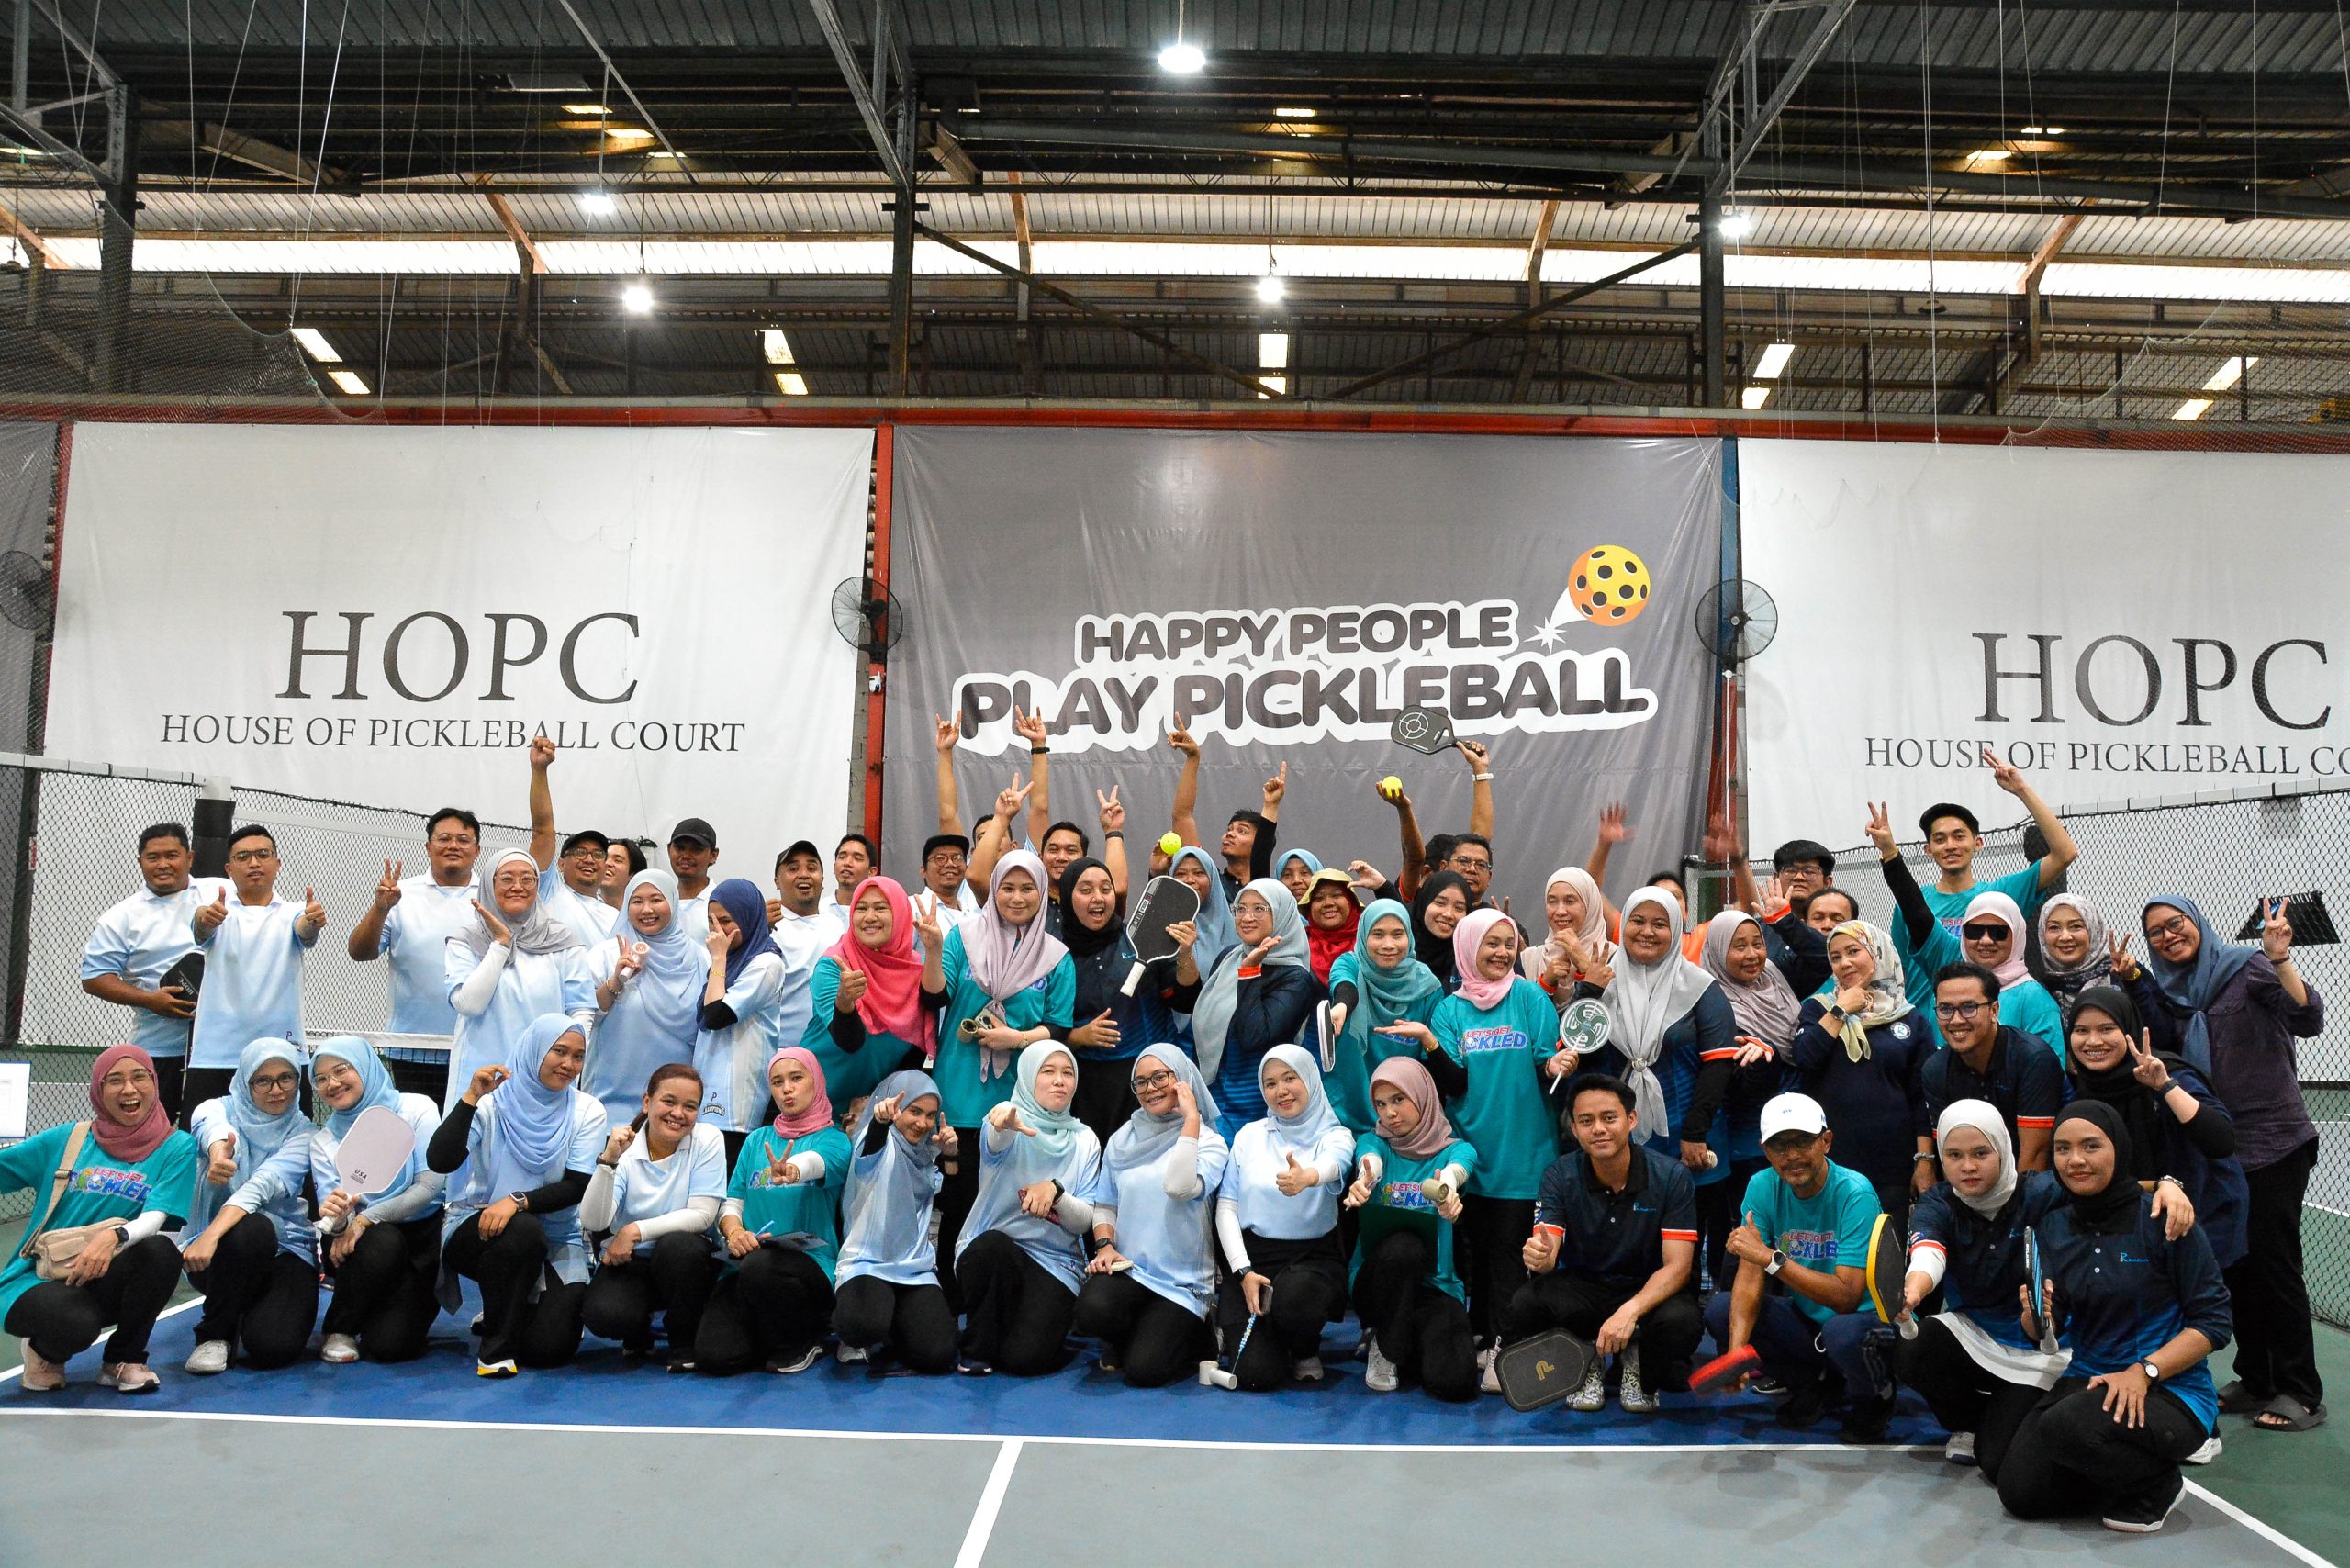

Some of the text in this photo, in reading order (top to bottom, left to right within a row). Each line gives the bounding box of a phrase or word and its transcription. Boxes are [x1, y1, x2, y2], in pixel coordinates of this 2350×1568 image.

[1081, 607, 1512, 663] HAPPY PEOPLE
[275, 611, 639, 704] HOPC
[960, 656, 1650, 739] PLAY PICKLEBALL
[1972, 633, 2331, 730] HOPC
[161, 714, 745, 752] HOUSE OF PICKLEBALL COURT
[1865, 737, 1994, 768] HOUSE
[2008, 741, 2057, 770] OF
[2068, 742, 2300, 774] PICKLEBALL
[1458, 1032, 1528, 1052] CKLED
[1466, 1026, 1511, 1038] LET'S GET
[93, 1167, 125, 1181] LET'S
[354, 1169, 367, 1180] USA
[1393, 1182, 1419, 1192] LET'S
